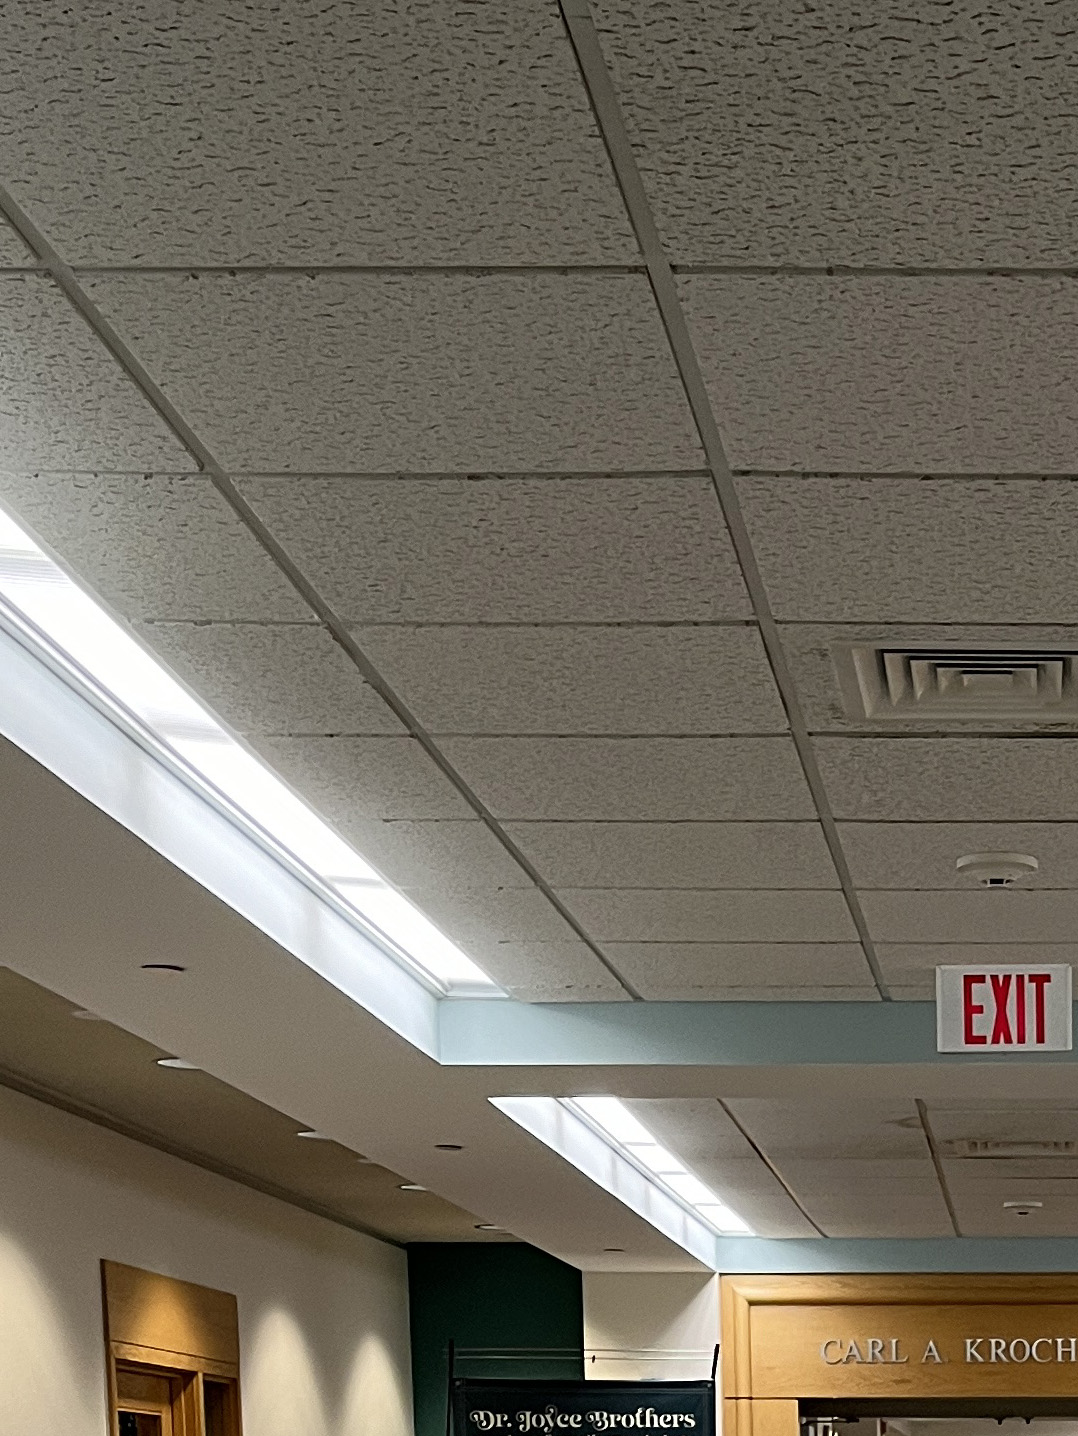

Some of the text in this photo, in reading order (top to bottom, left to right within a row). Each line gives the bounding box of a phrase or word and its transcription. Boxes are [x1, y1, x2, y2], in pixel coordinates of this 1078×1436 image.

[963, 974, 1052, 1045] EXIT
[820, 1338, 909, 1364] CARL
[964, 1338, 1078, 1363] KROCH
[469, 1404, 696, 1433] Dr. Joyce Brothers
